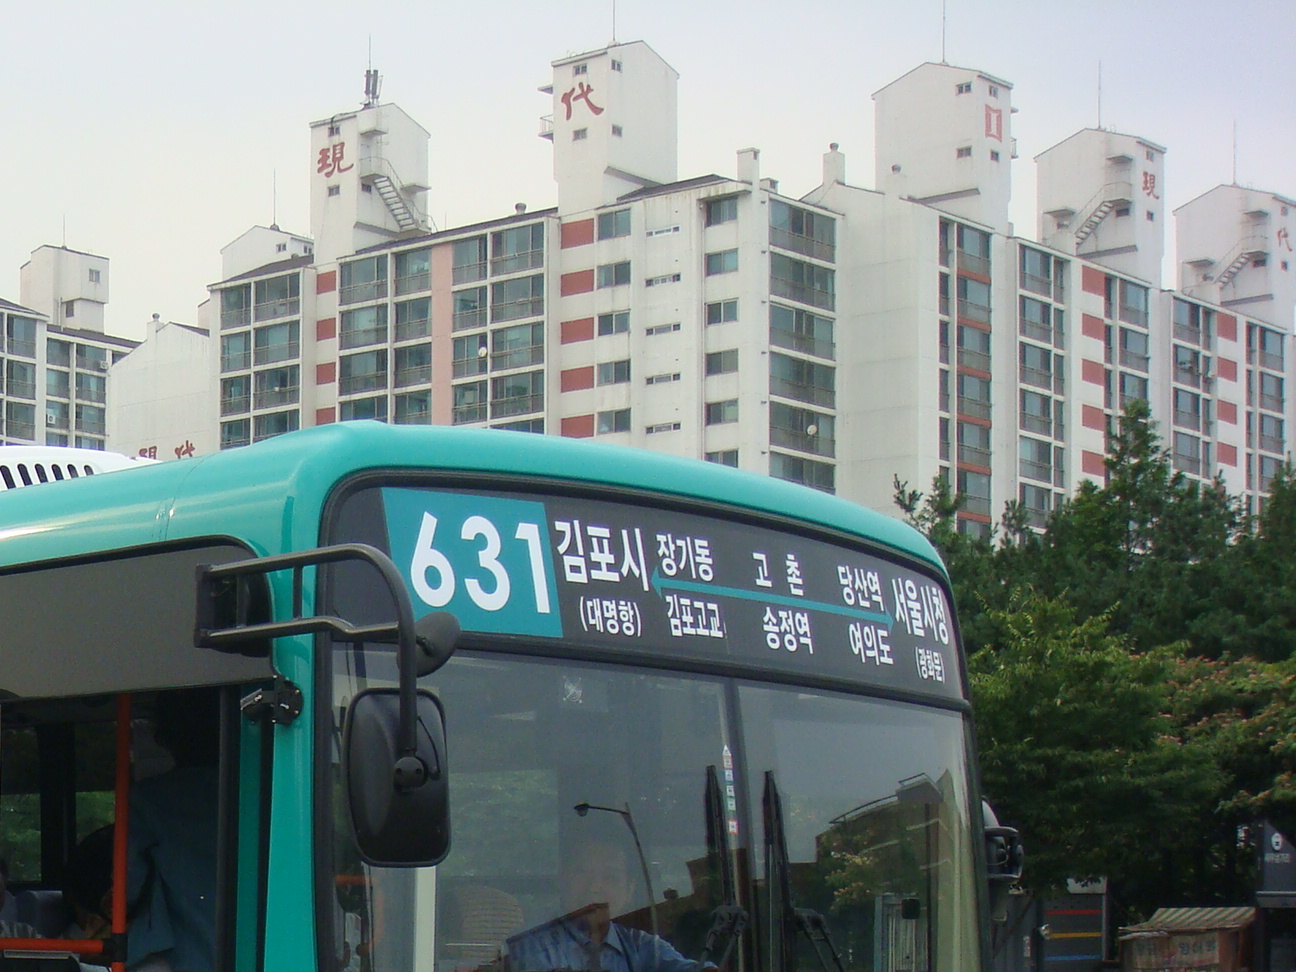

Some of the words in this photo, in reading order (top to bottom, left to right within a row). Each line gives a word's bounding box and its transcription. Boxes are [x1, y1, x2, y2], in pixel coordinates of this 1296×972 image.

[561, 82, 604, 120] 代
[317, 142, 354, 177] 現
[1142, 172, 1159, 199] 現
[410, 511, 551, 614] 631
[554, 520, 649, 591] 김포시
[656, 533, 713, 582] 장기동
[752, 552, 804, 596] 고촌
[837, 565, 884, 611] 당산역
[580, 595, 642, 637] (대명항)
[665, 594, 724, 638] 김포고교
[762, 606, 813, 654] 송정역
[892, 577, 949, 645] 서울시청
[849, 622, 894, 666] 여의도
[915, 646, 946, 683] (광화문)
